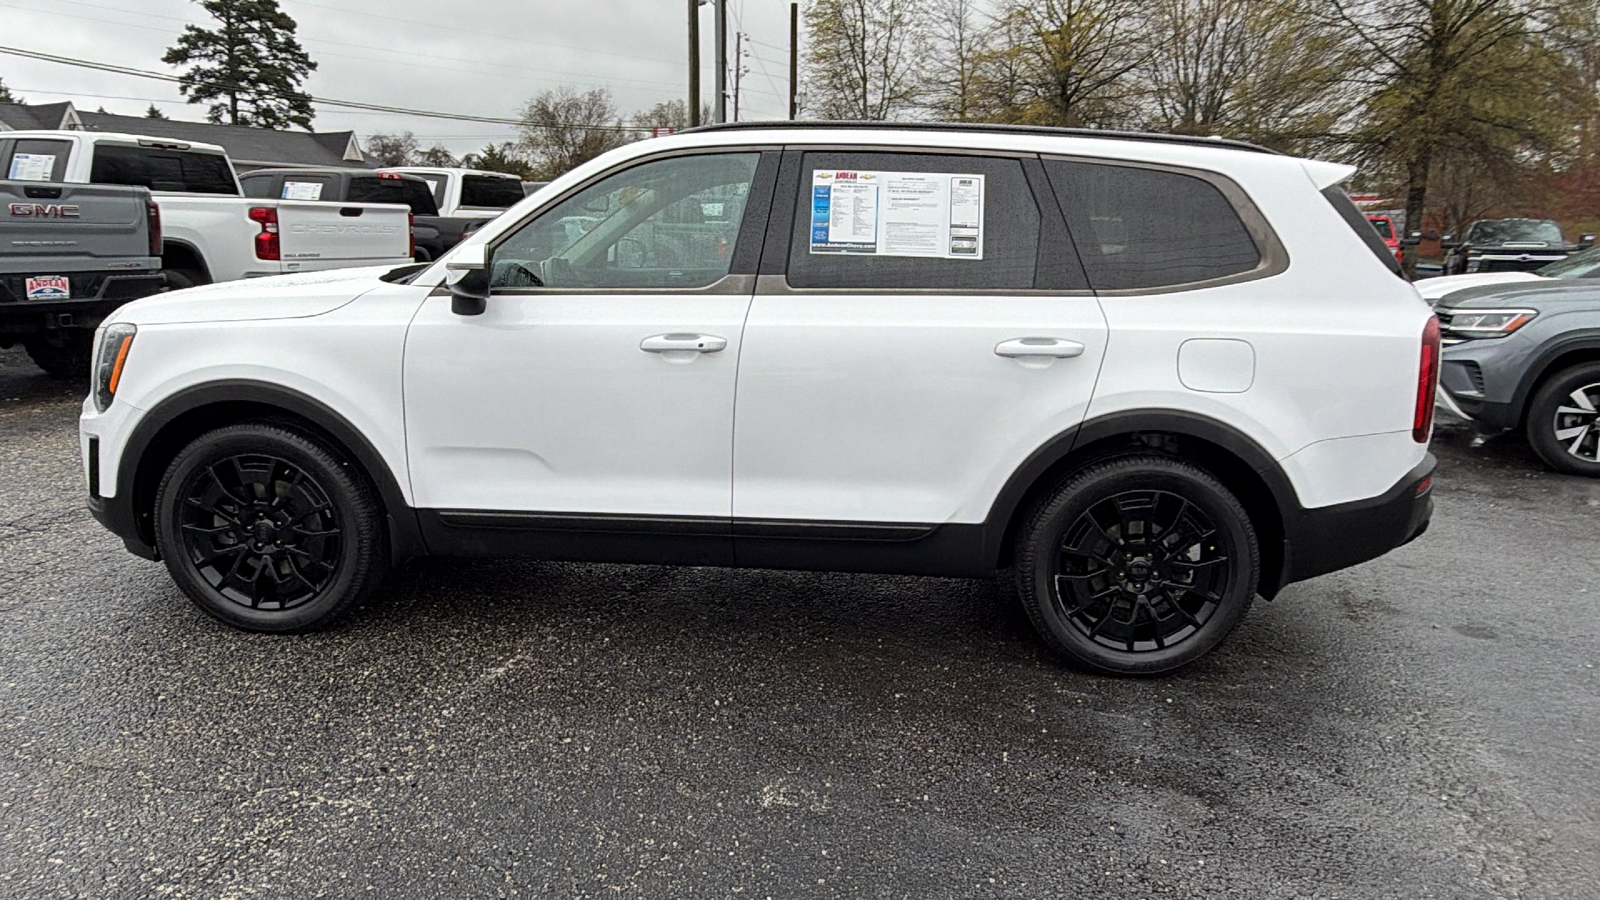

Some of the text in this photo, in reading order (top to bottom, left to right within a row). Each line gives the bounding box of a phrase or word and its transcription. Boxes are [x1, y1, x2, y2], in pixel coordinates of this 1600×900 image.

[835, 171, 857, 180] ANDEAN
[8, 202, 80, 219] GMC
[291, 223, 402, 236] CHEVROLET
[28, 279, 68, 292] ANDEAN
